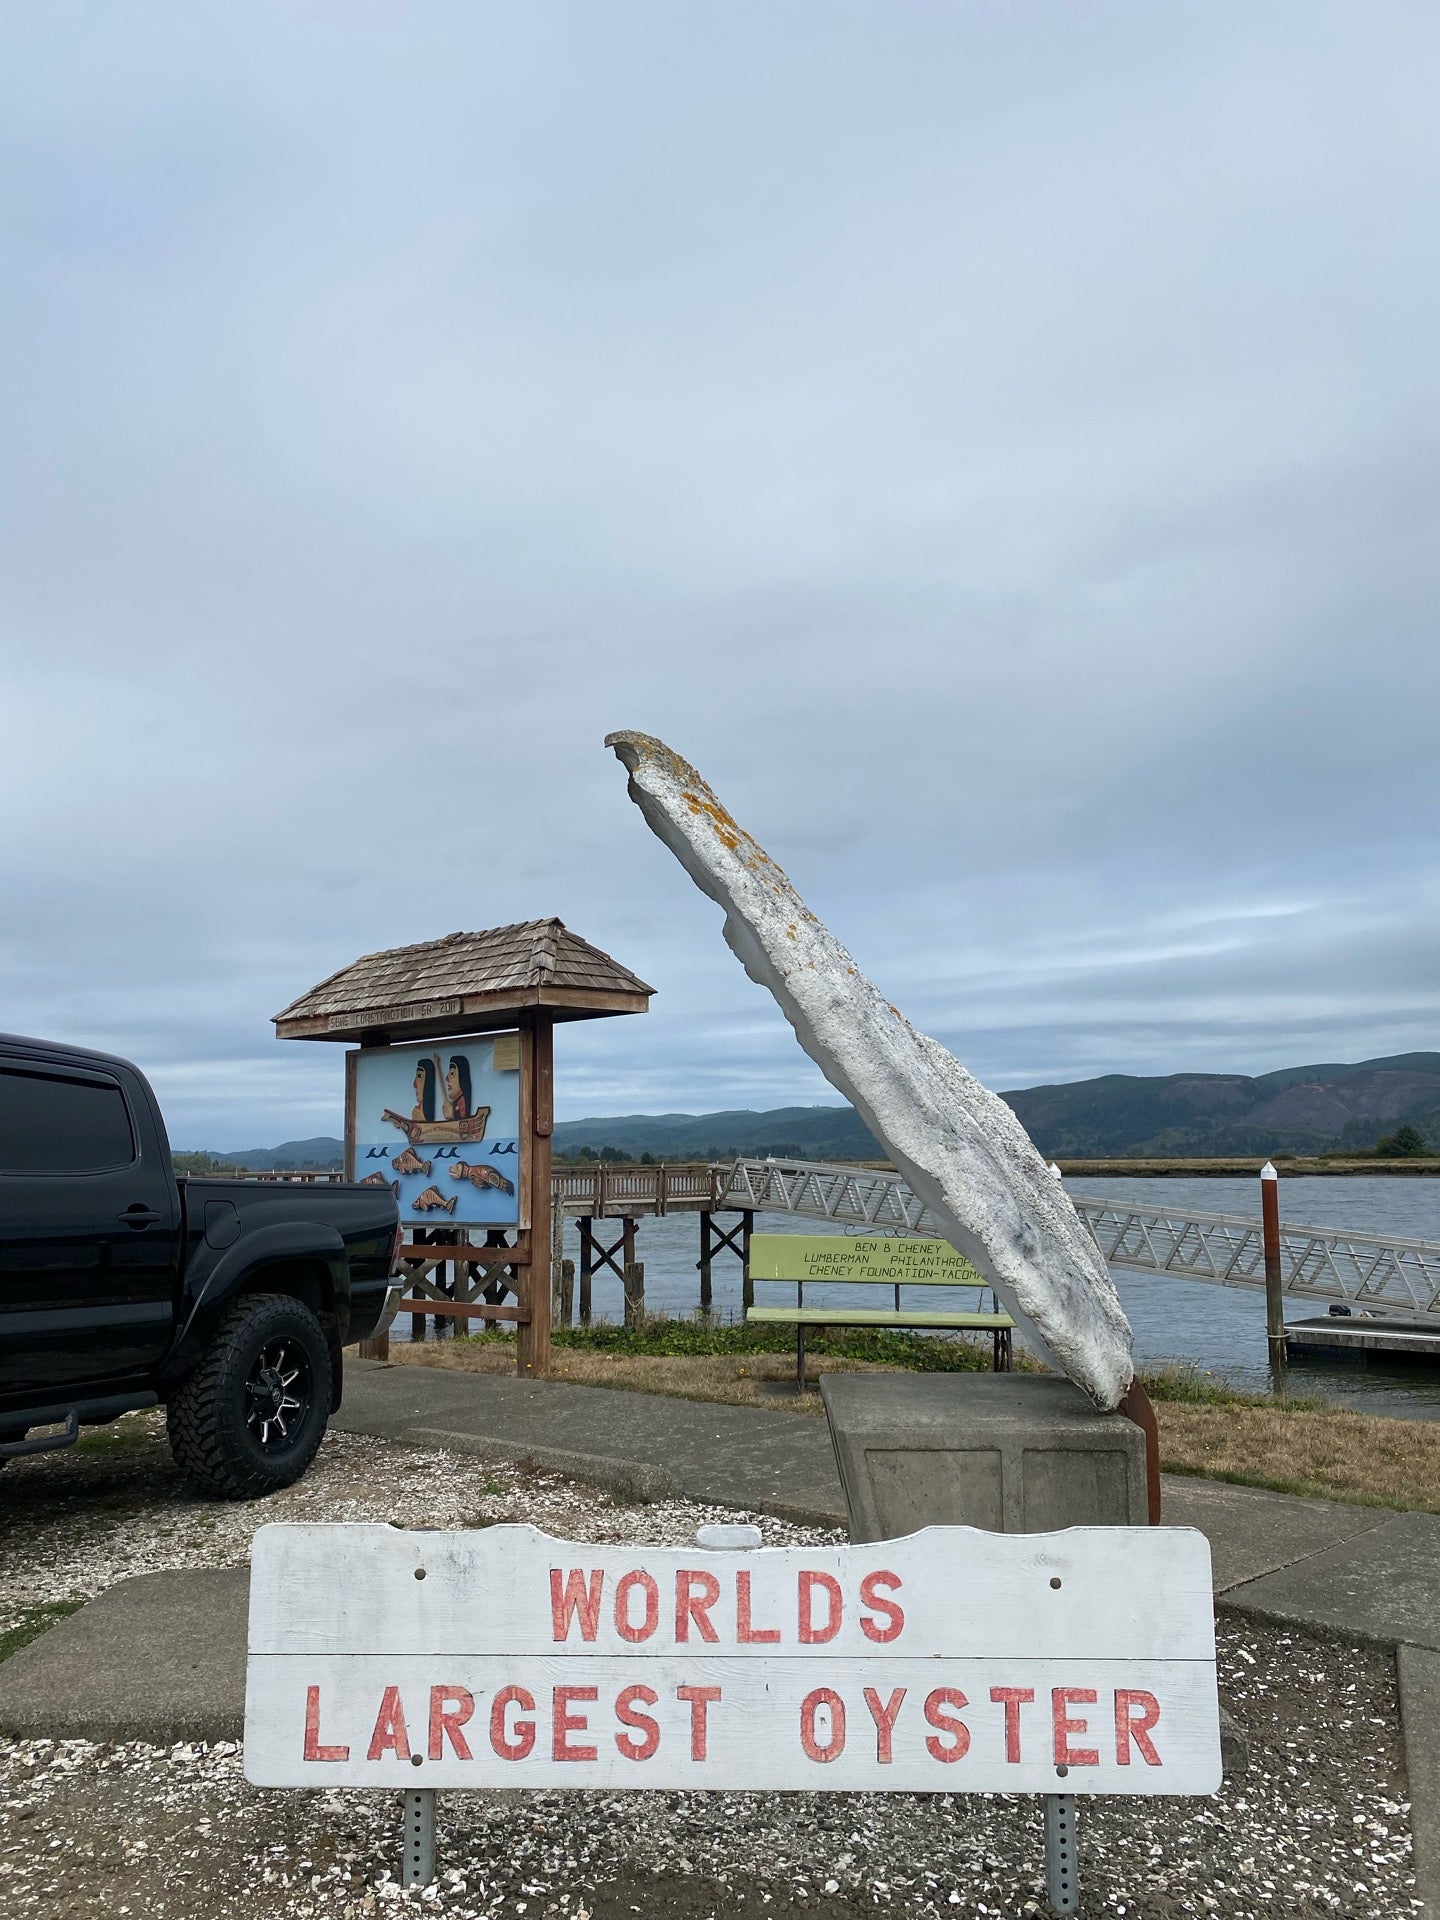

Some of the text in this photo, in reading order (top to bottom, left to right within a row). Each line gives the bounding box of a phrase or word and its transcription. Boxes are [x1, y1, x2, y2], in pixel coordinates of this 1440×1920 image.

[355, 1007, 414, 1025] CONSTRUCTION
[439, 1001, 457, 1014] 2011
[854, 1242, 942, 1254] BEN B CHENEY
[804, 1253, 975, 1267] LUMBERMAN PHILANTHROP
[809, 1265, 852, 1276] CHENEY
[550, 1568, 905, 1644] WORLDS
[304, 1684, 1163, 1766] LARGEST OYSTER
